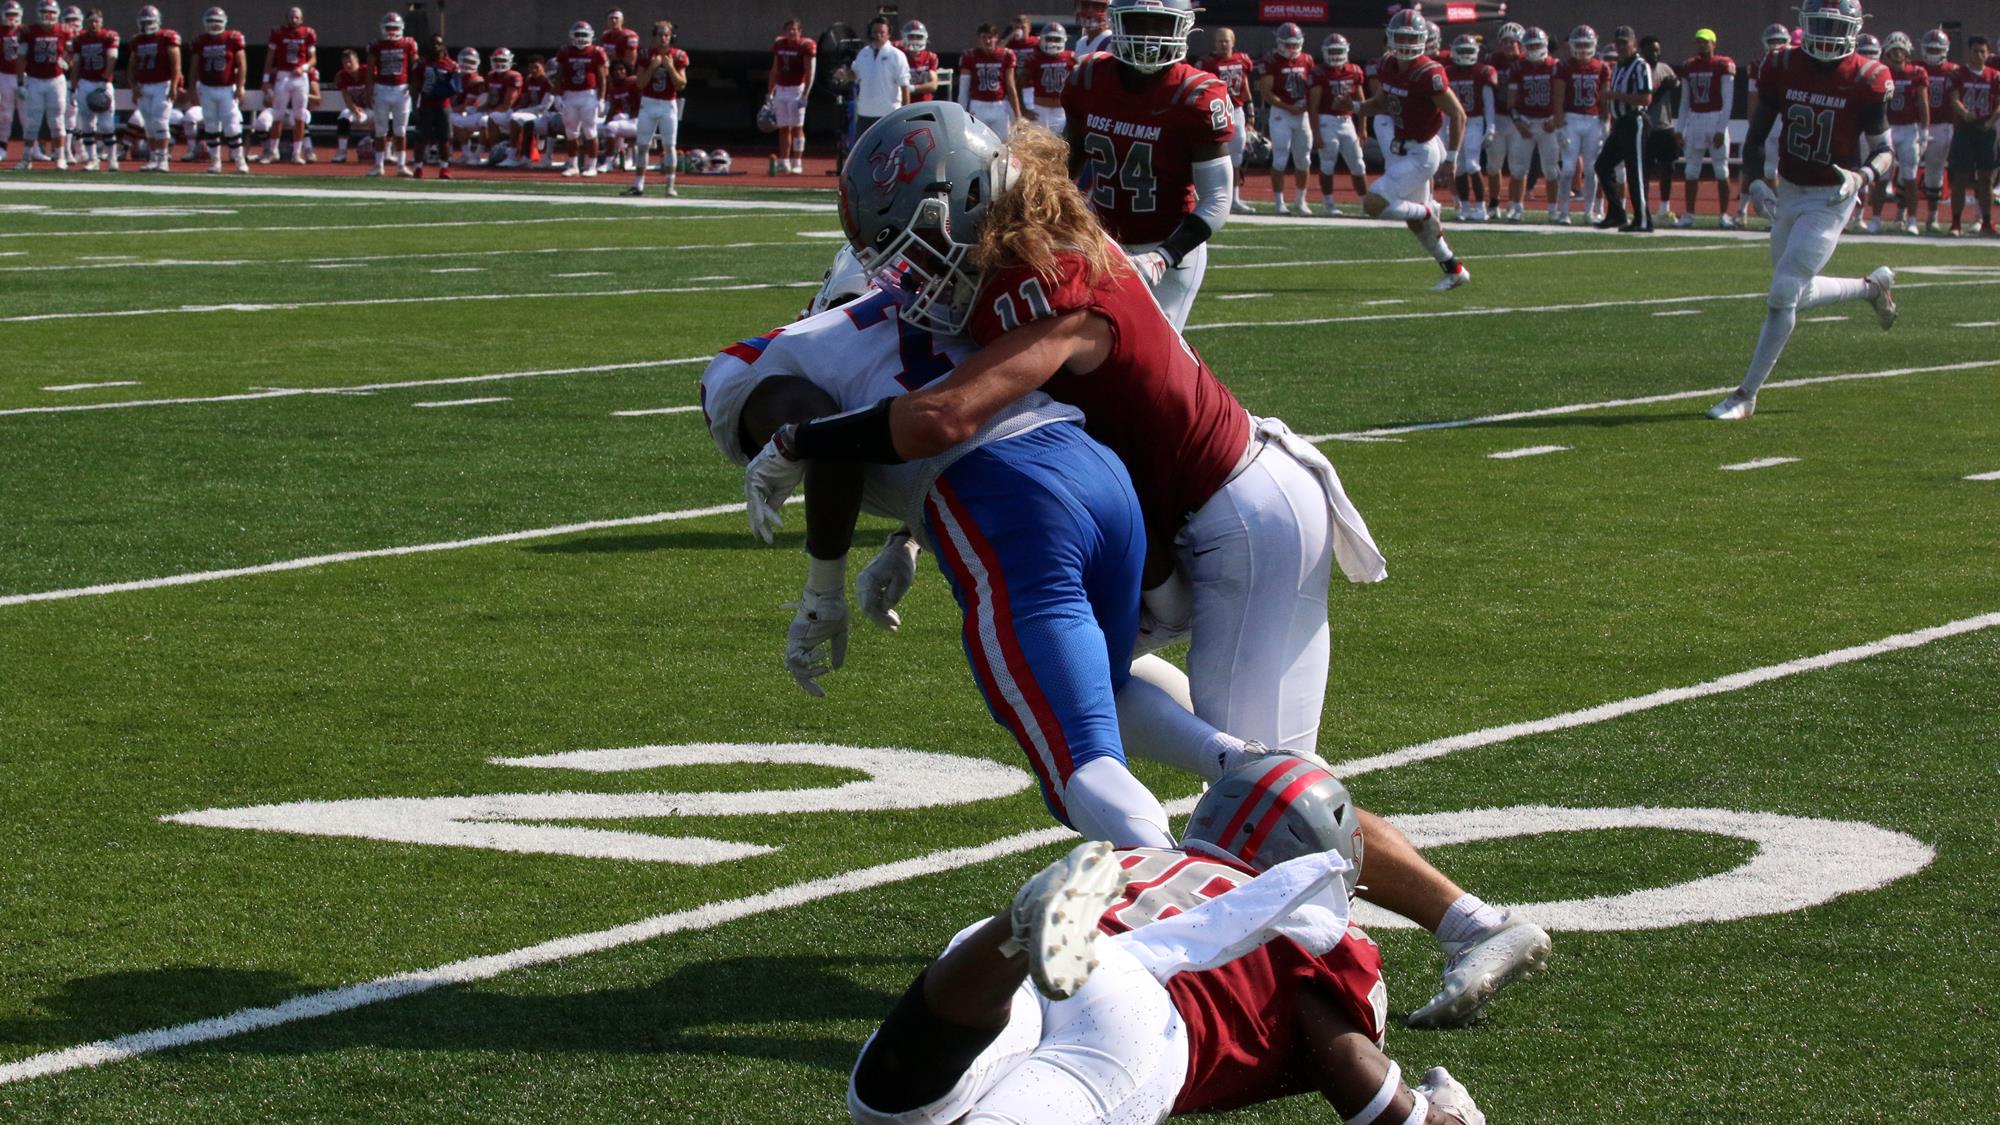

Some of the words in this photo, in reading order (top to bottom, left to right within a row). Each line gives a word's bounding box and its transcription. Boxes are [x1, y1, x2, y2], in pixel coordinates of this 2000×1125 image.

[1573, 80, 1597, 106] 13
[1785, 88, 1847, 109] ROSE-HULMAN
[1963, 87, 1991, 116] 44
[1087, 113, 1162, 141] ROSE-HULMAN
[1209, 94, 1235, 131] 24
[1787, 103, 1835, 165] 21
[1084, 132, 1157, 213] 24
[993, 277, 1057, 332] 11
